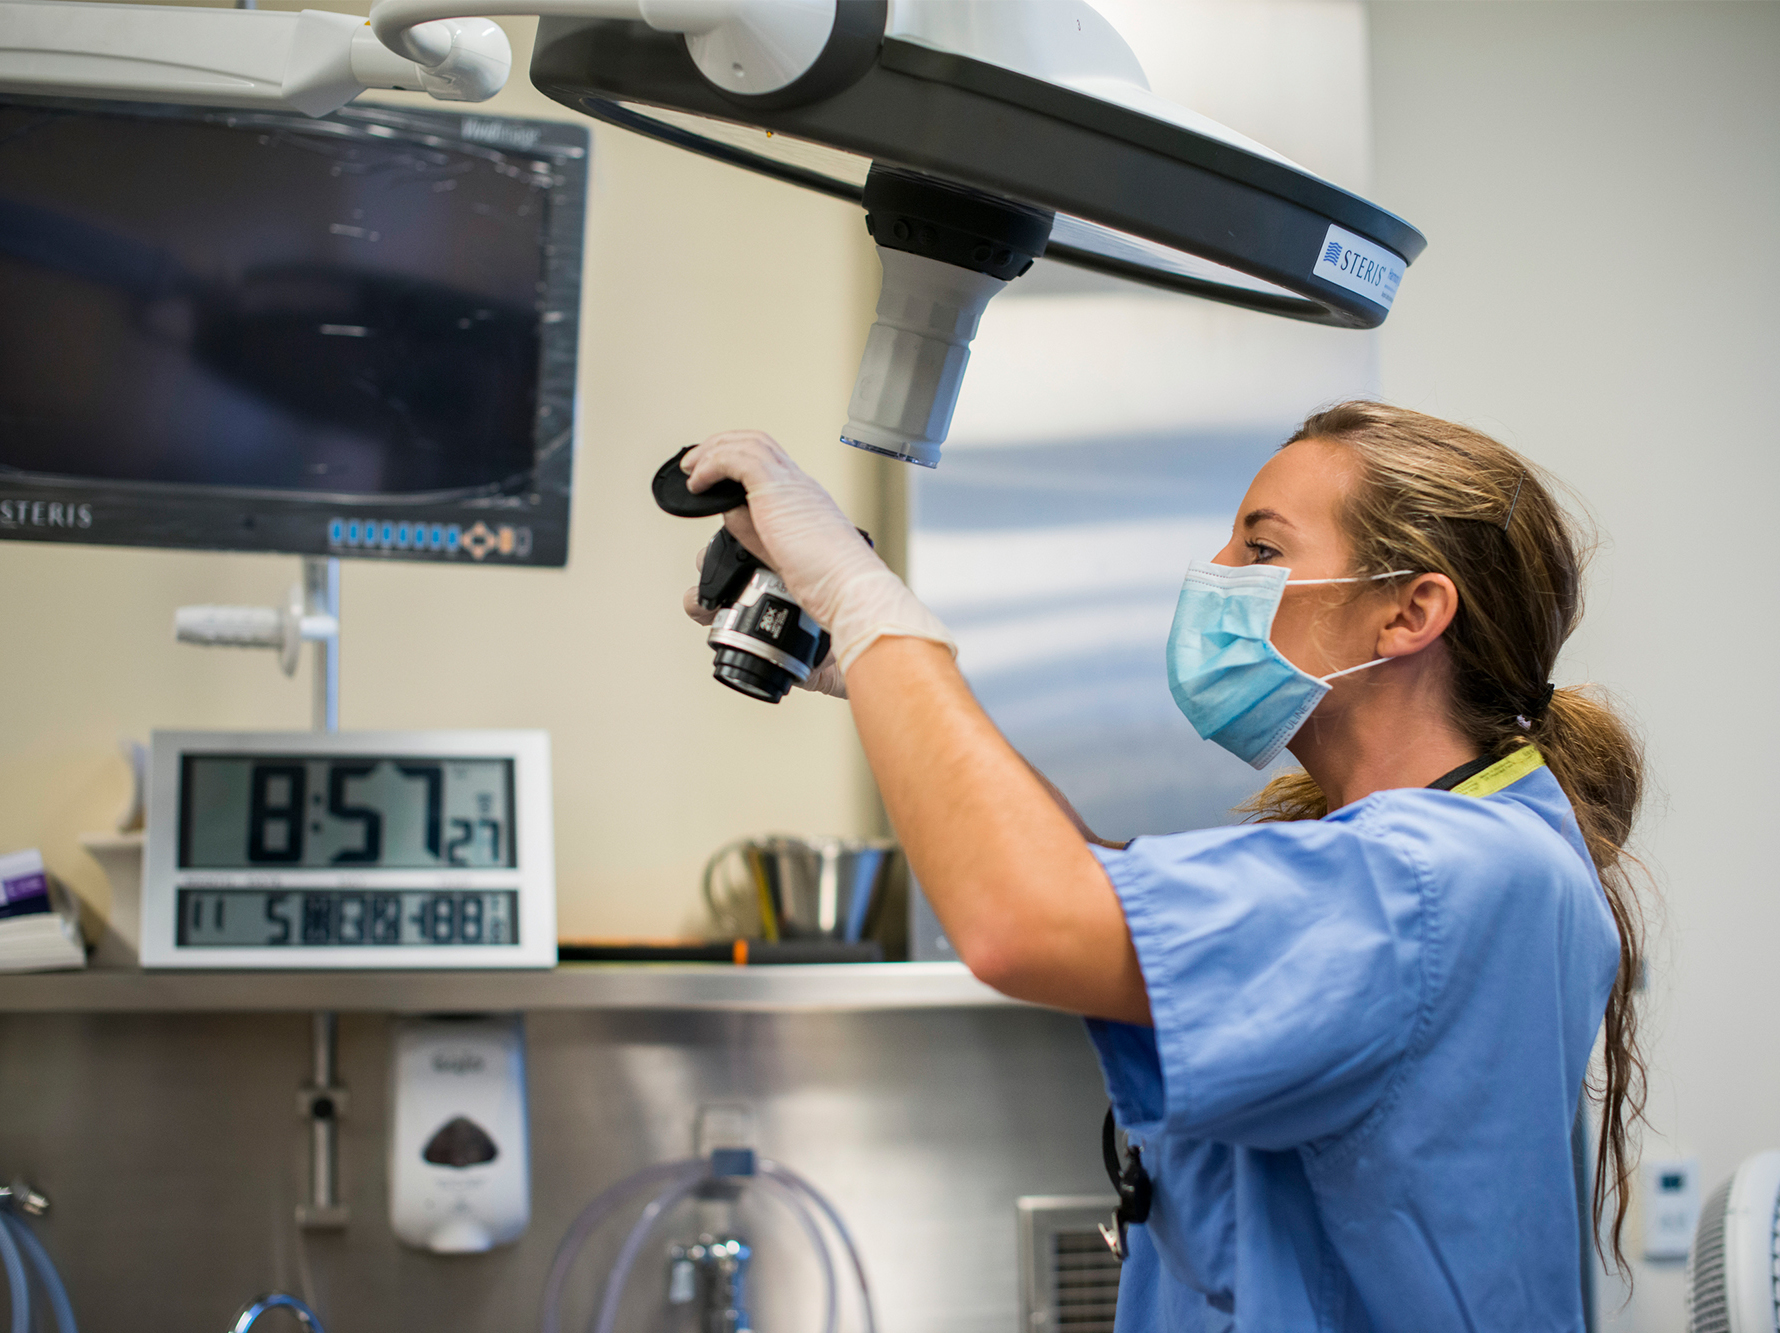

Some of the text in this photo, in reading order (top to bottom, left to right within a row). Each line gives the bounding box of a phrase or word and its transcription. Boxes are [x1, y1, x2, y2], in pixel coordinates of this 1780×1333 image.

[1340, 249, 1386, 287] STERIS
[0, 499, 93, 529] STERIS
[1284, 704, 1310, 730] ULINE
[247, 764, 500, 867] 8:57 27
